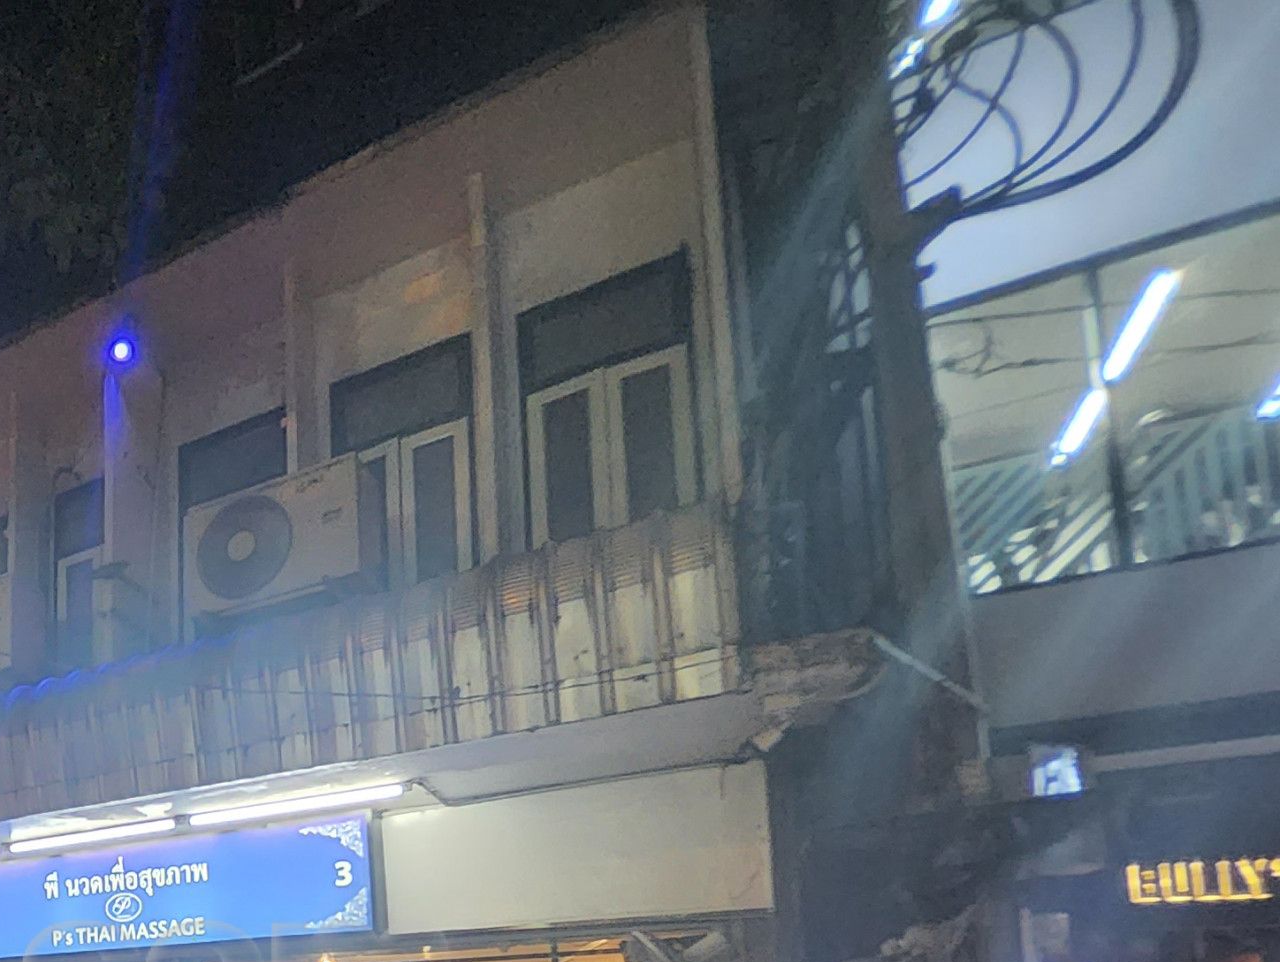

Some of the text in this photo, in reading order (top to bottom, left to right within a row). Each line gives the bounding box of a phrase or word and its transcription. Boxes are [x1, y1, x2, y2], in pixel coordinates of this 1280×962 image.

[65, 856, 209, 897] นวดเพื่อสุขภาพ
[333, 860, 354, 889] 3
[76, 924, 116, 944] THAI
[120, 917, 205, 942] MASSAGE
